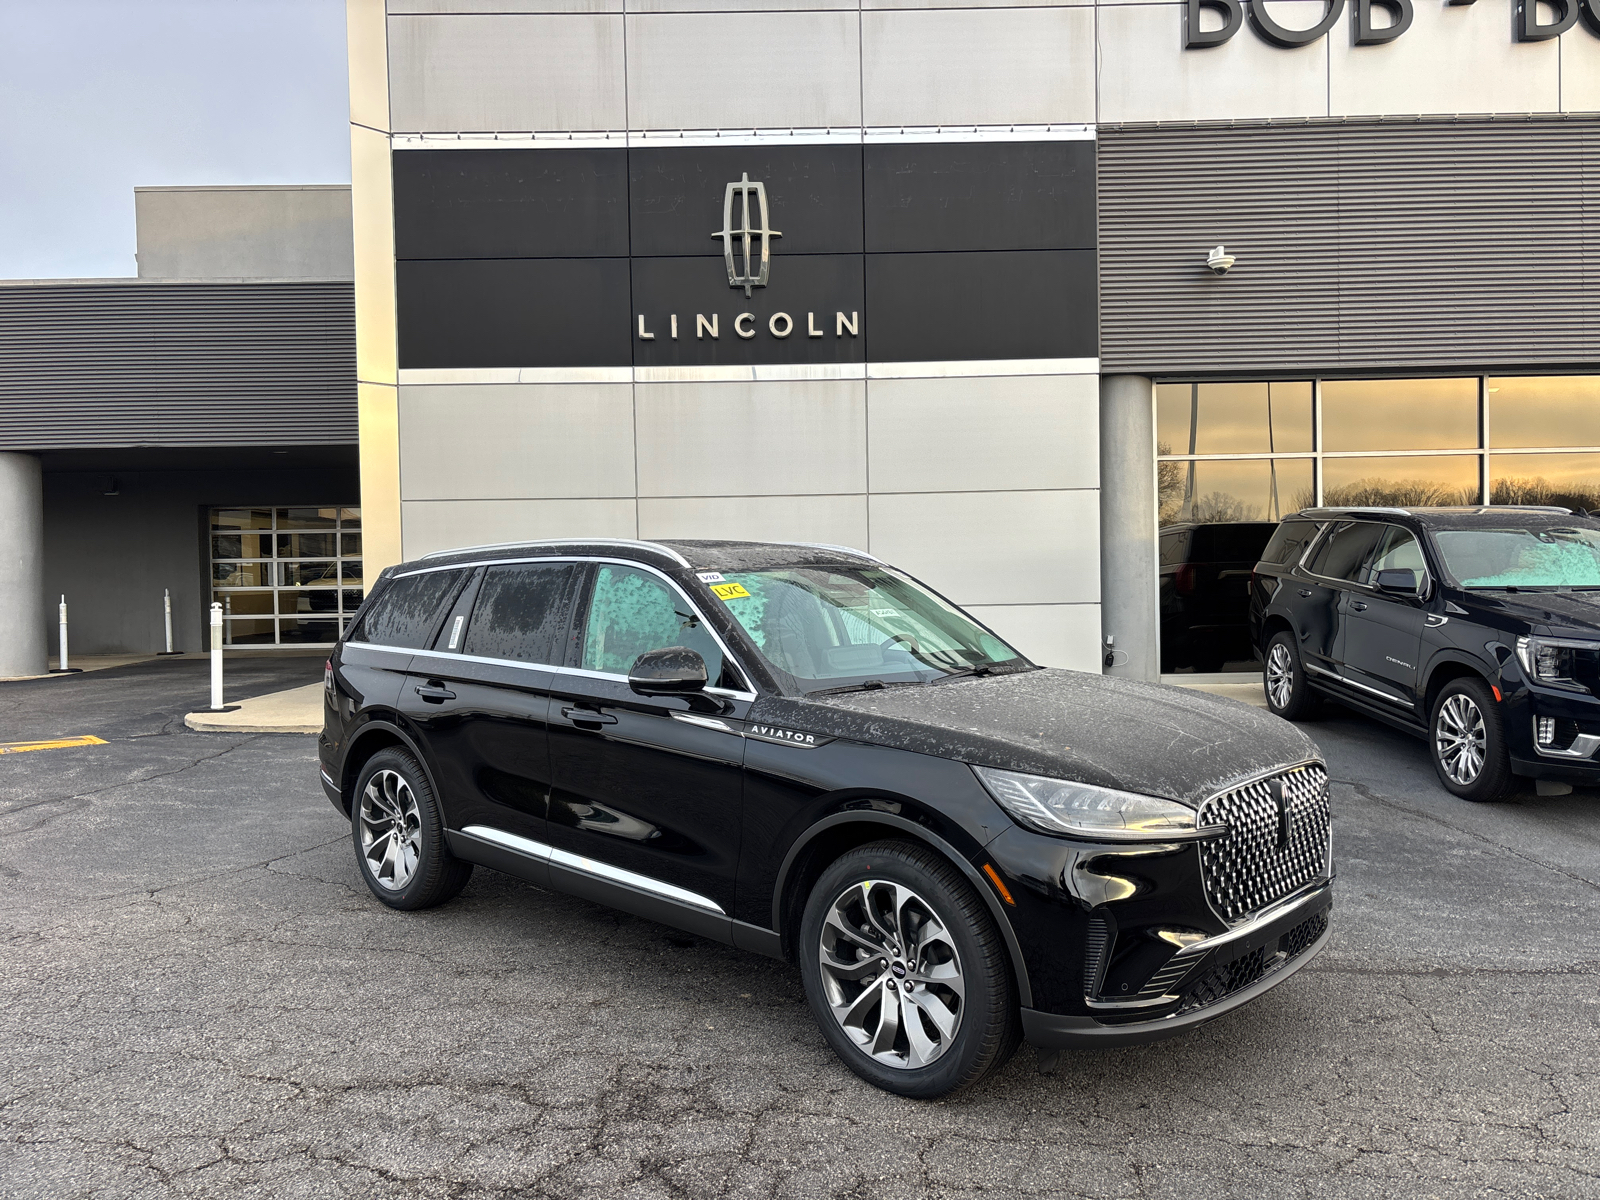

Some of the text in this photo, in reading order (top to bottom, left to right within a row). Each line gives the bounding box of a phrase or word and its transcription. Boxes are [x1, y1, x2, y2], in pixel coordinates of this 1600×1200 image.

[638, 311, 859, 341] LINCOLN
[714, 585, 746, 597] LVC
[751, 725, 815, 744] AVIATOR
